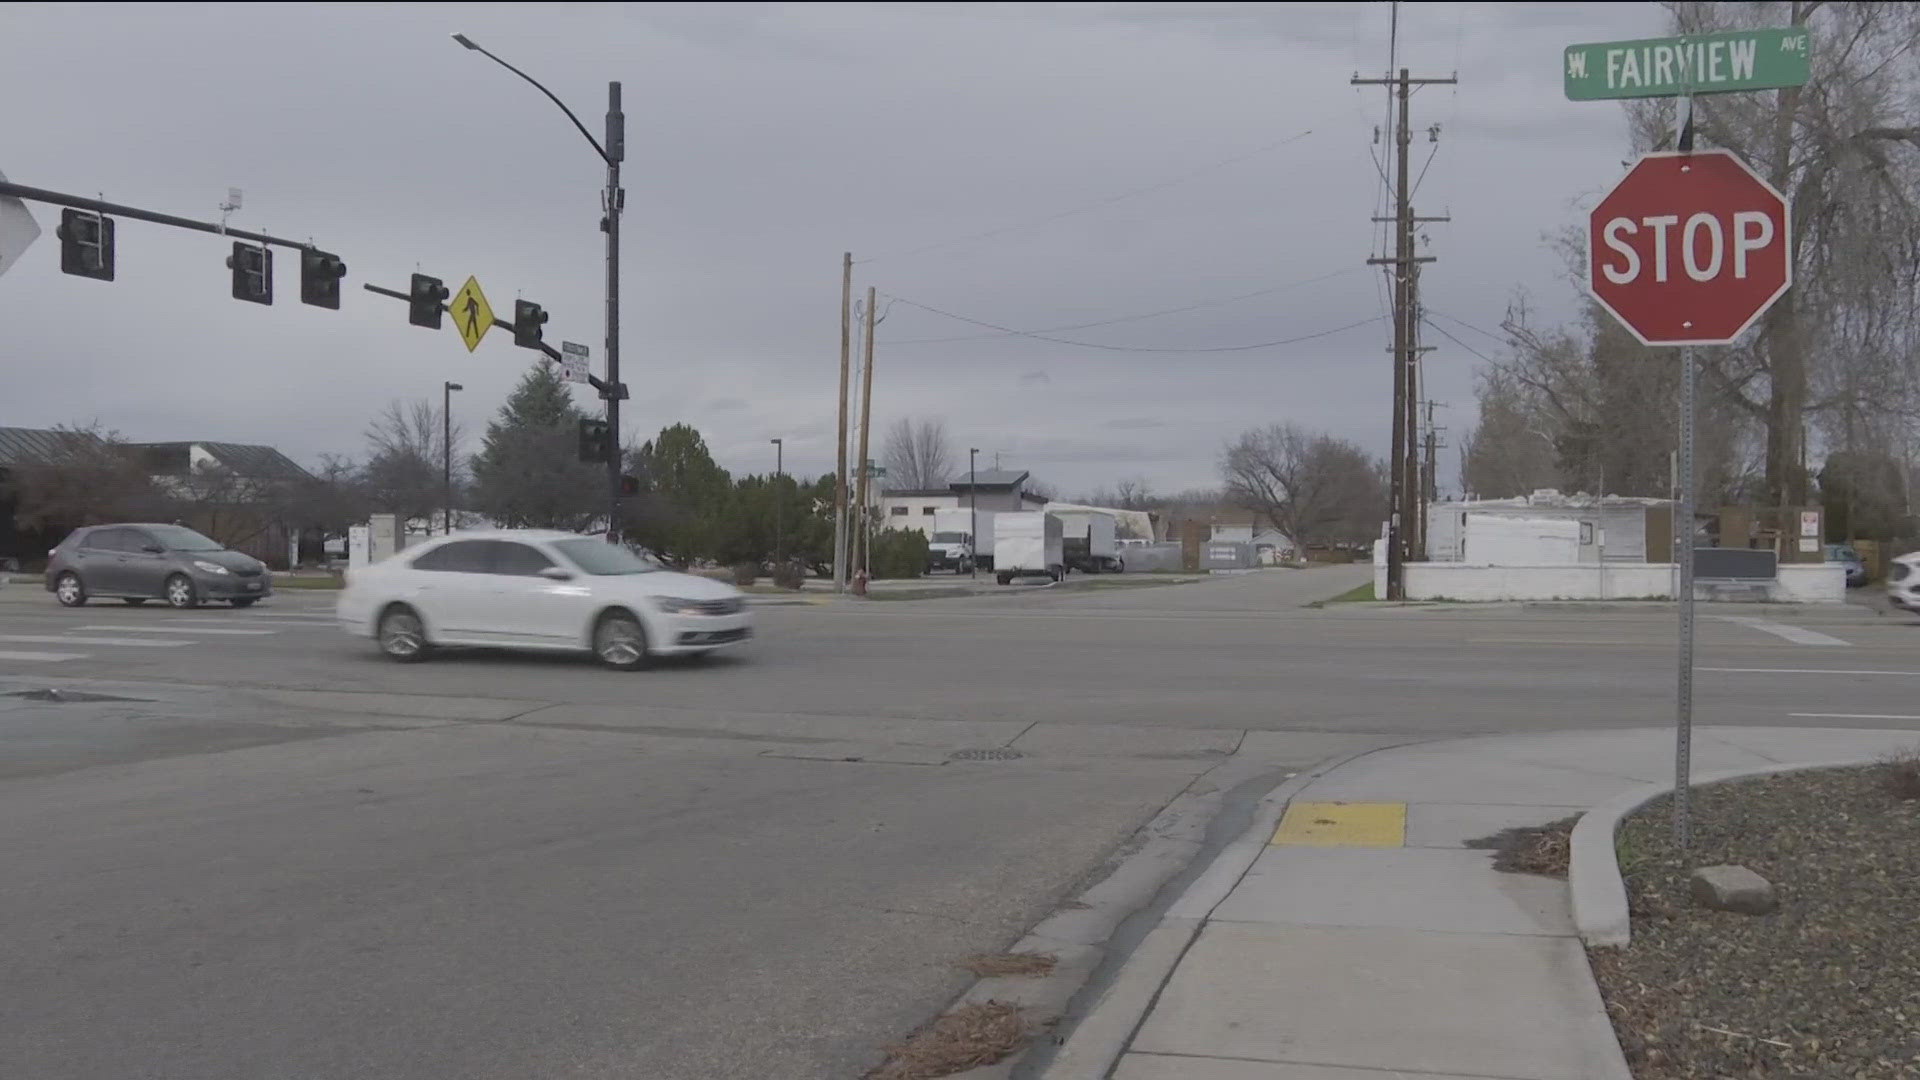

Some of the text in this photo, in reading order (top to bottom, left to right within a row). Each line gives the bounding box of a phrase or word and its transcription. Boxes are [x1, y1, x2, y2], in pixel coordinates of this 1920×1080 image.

[1606, 39, 1757, 89] FAIRVIEW
[1780, 34, 1806, 51] AVE
[1602, 211, 1774, 285] STOP
